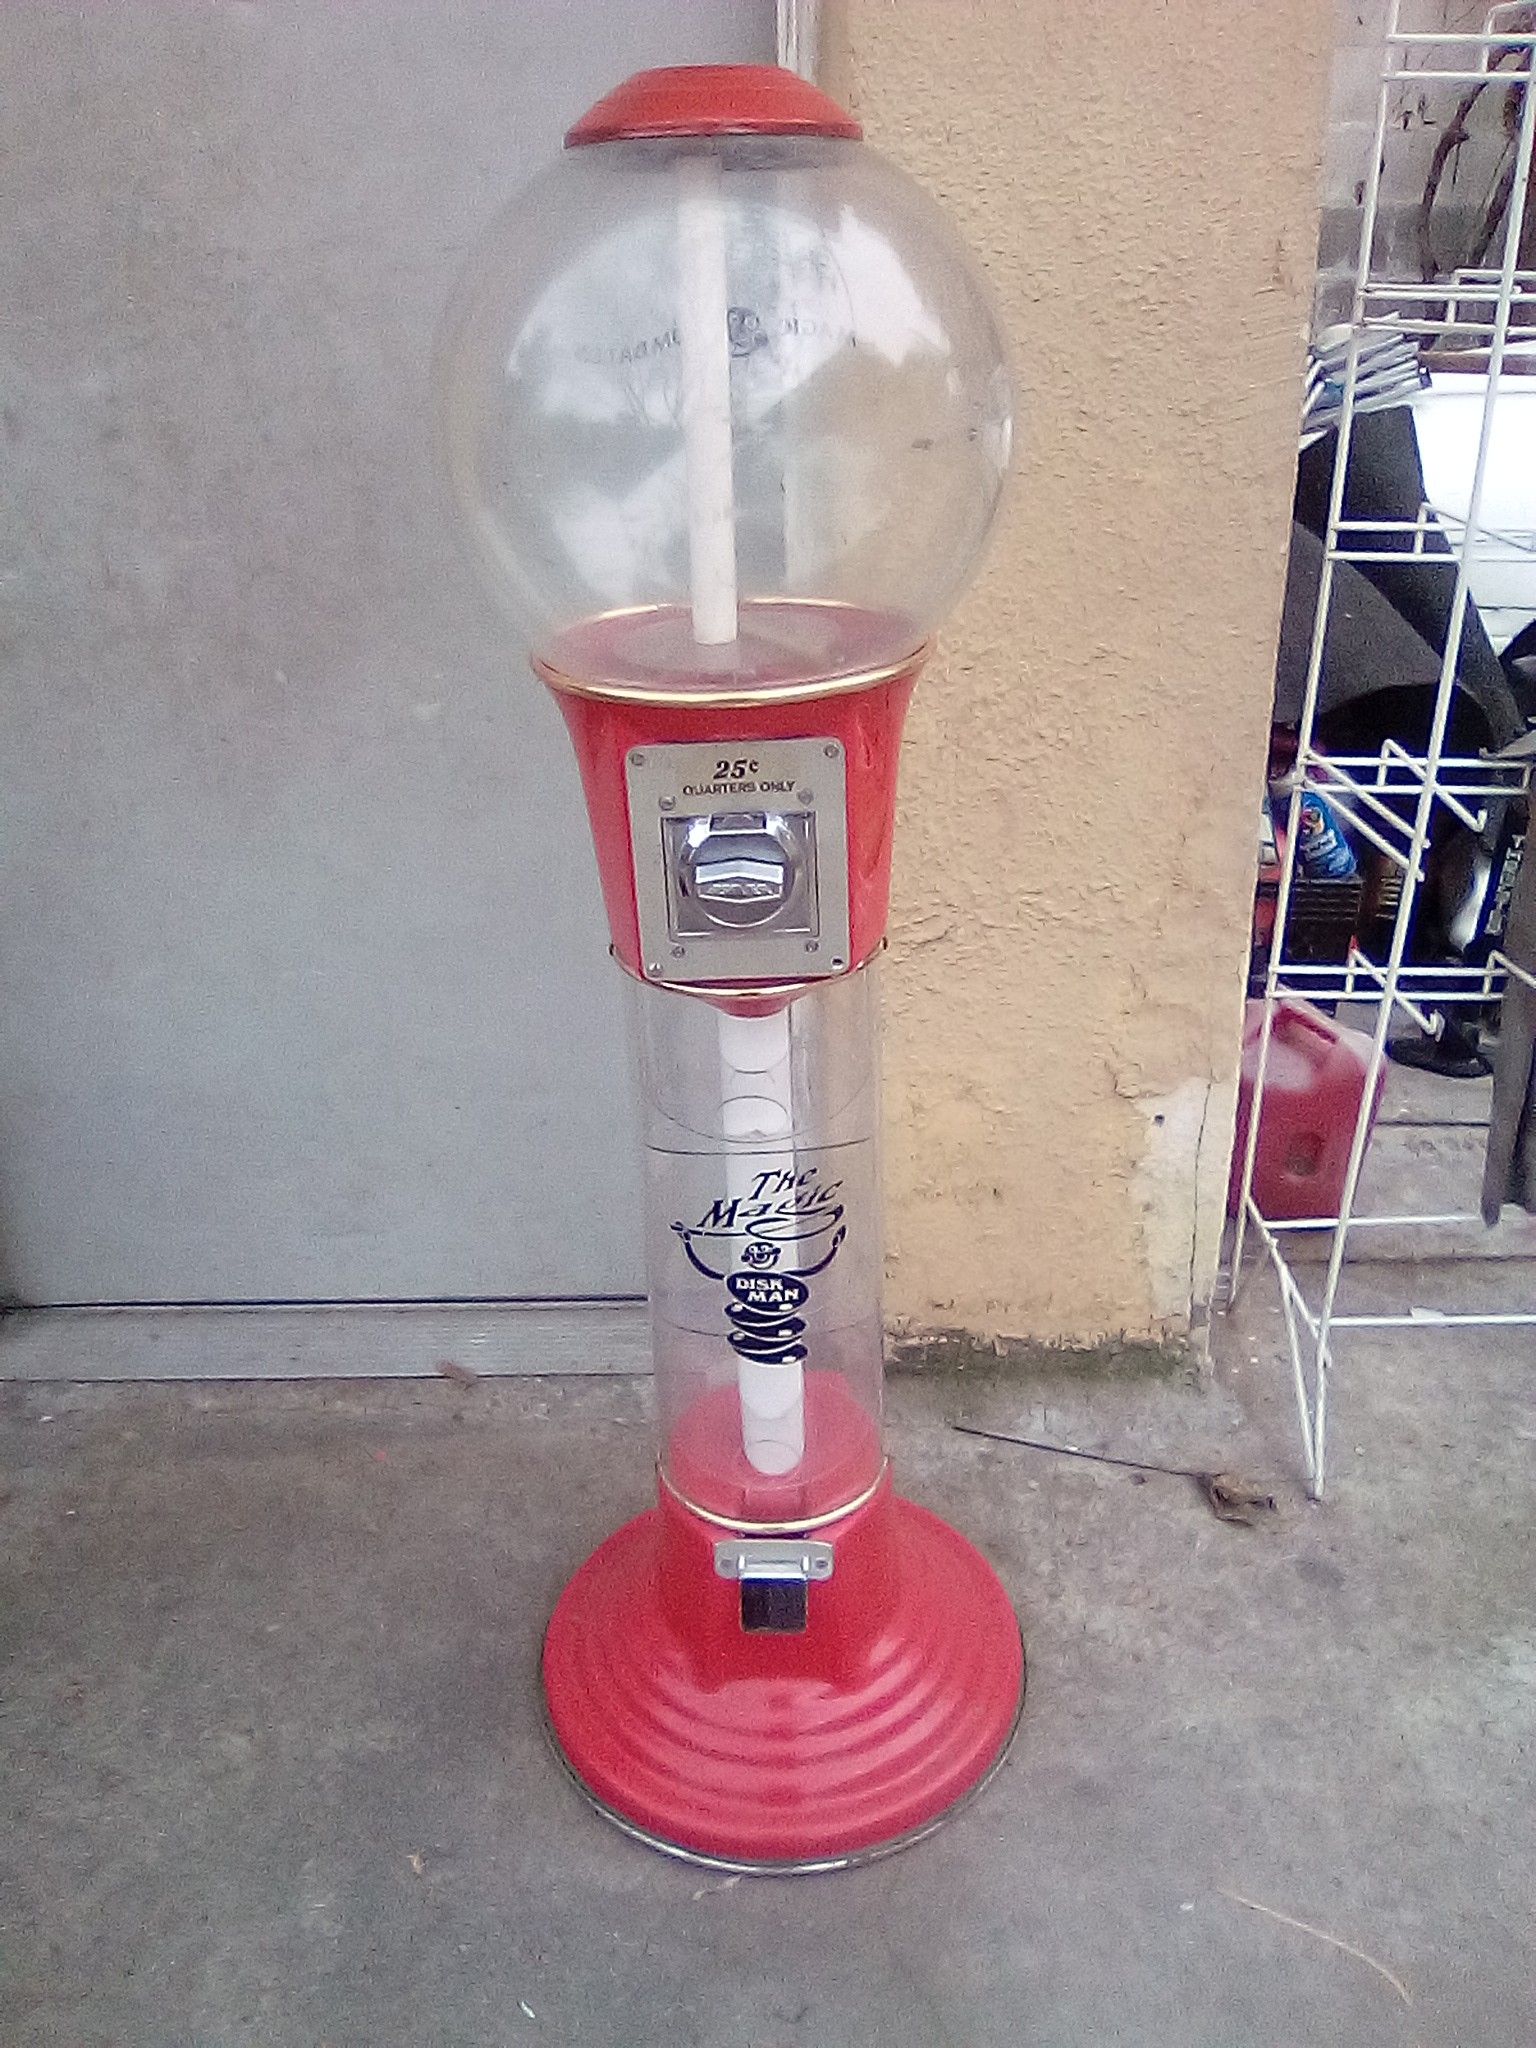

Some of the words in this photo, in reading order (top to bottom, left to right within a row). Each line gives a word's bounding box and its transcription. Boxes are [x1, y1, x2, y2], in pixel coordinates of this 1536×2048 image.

[682, 782, 758, 797] QUARTERS
[760, 780, 796, 793] ONLY
[735, 1277, 784, 1291] DISK
[746, 1288, 800, 1303] MAN
